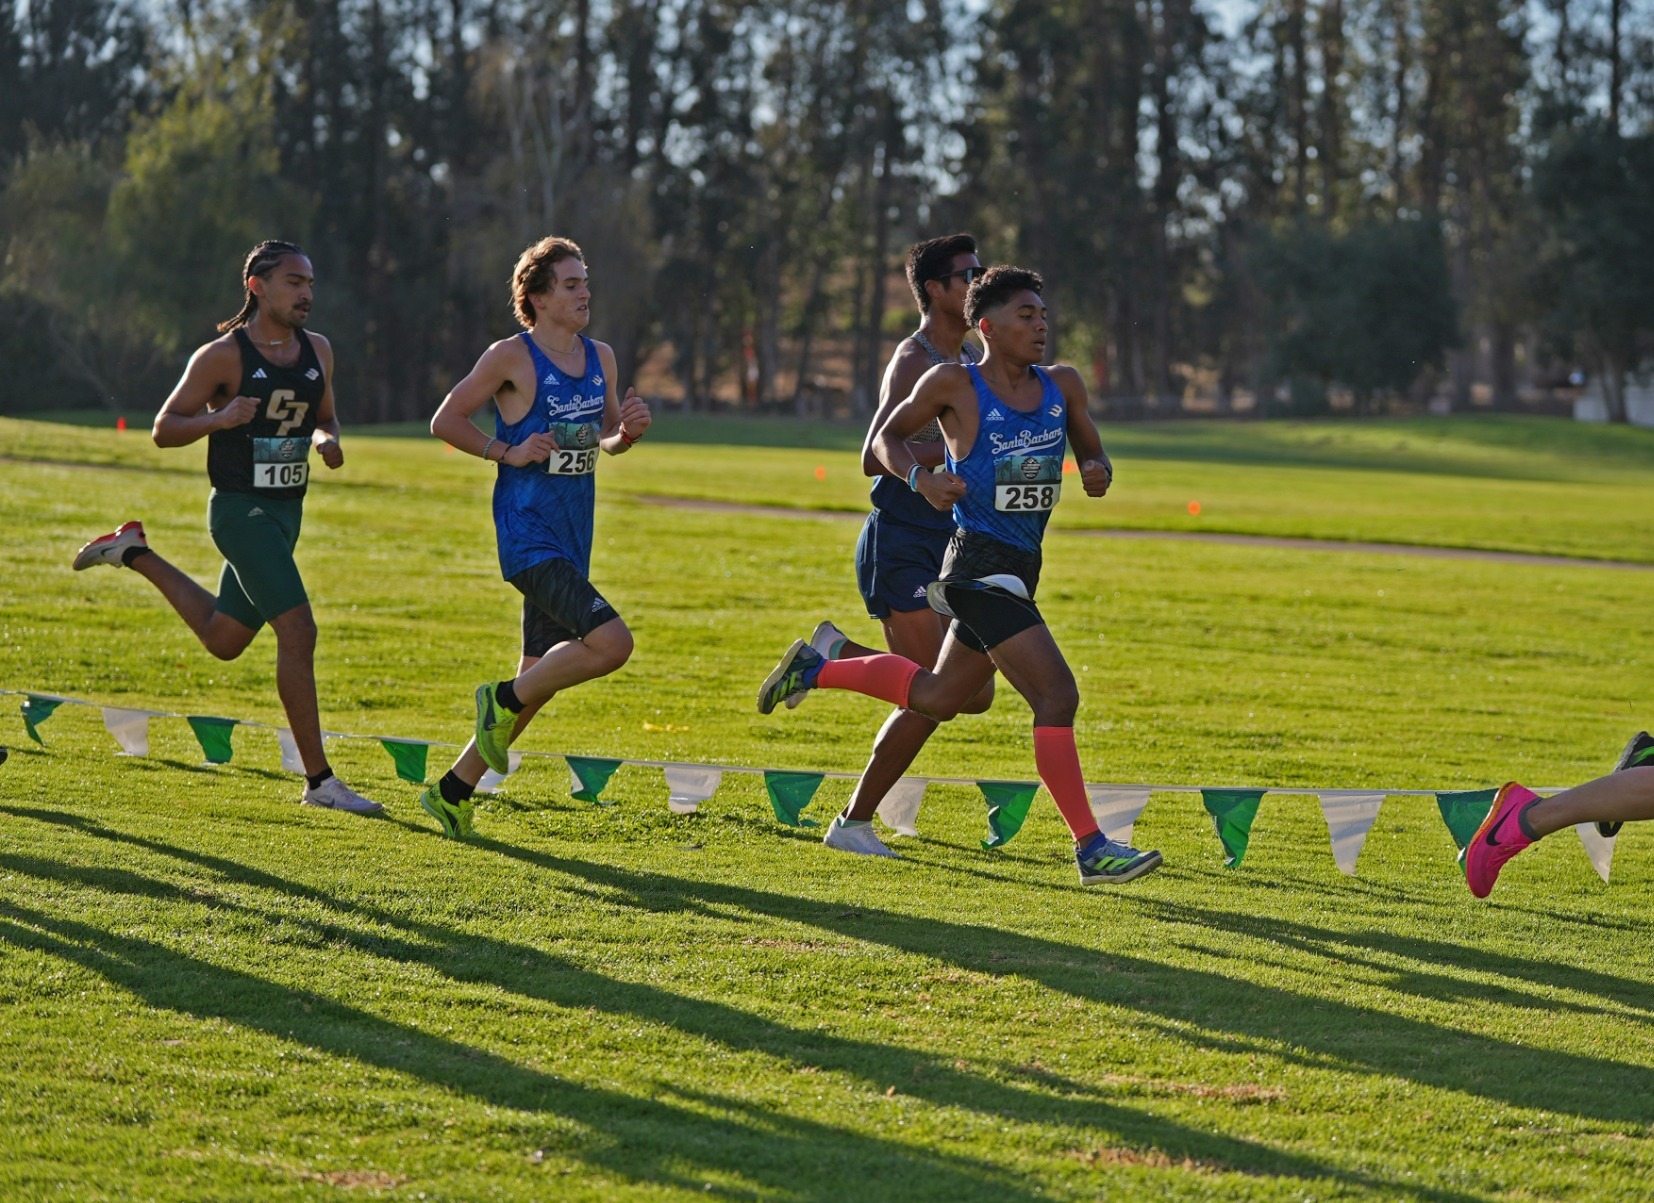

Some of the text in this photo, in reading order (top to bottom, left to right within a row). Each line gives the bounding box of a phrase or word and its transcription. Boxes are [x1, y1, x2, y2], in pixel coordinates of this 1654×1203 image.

[547, 395, 577, 417] Santa
[989, 432, 1022, 455] Santa
[558, 450, 595, 473] 256
[264, 465, 303, 485] 105
[1005, 486, 1054, 509] 258
